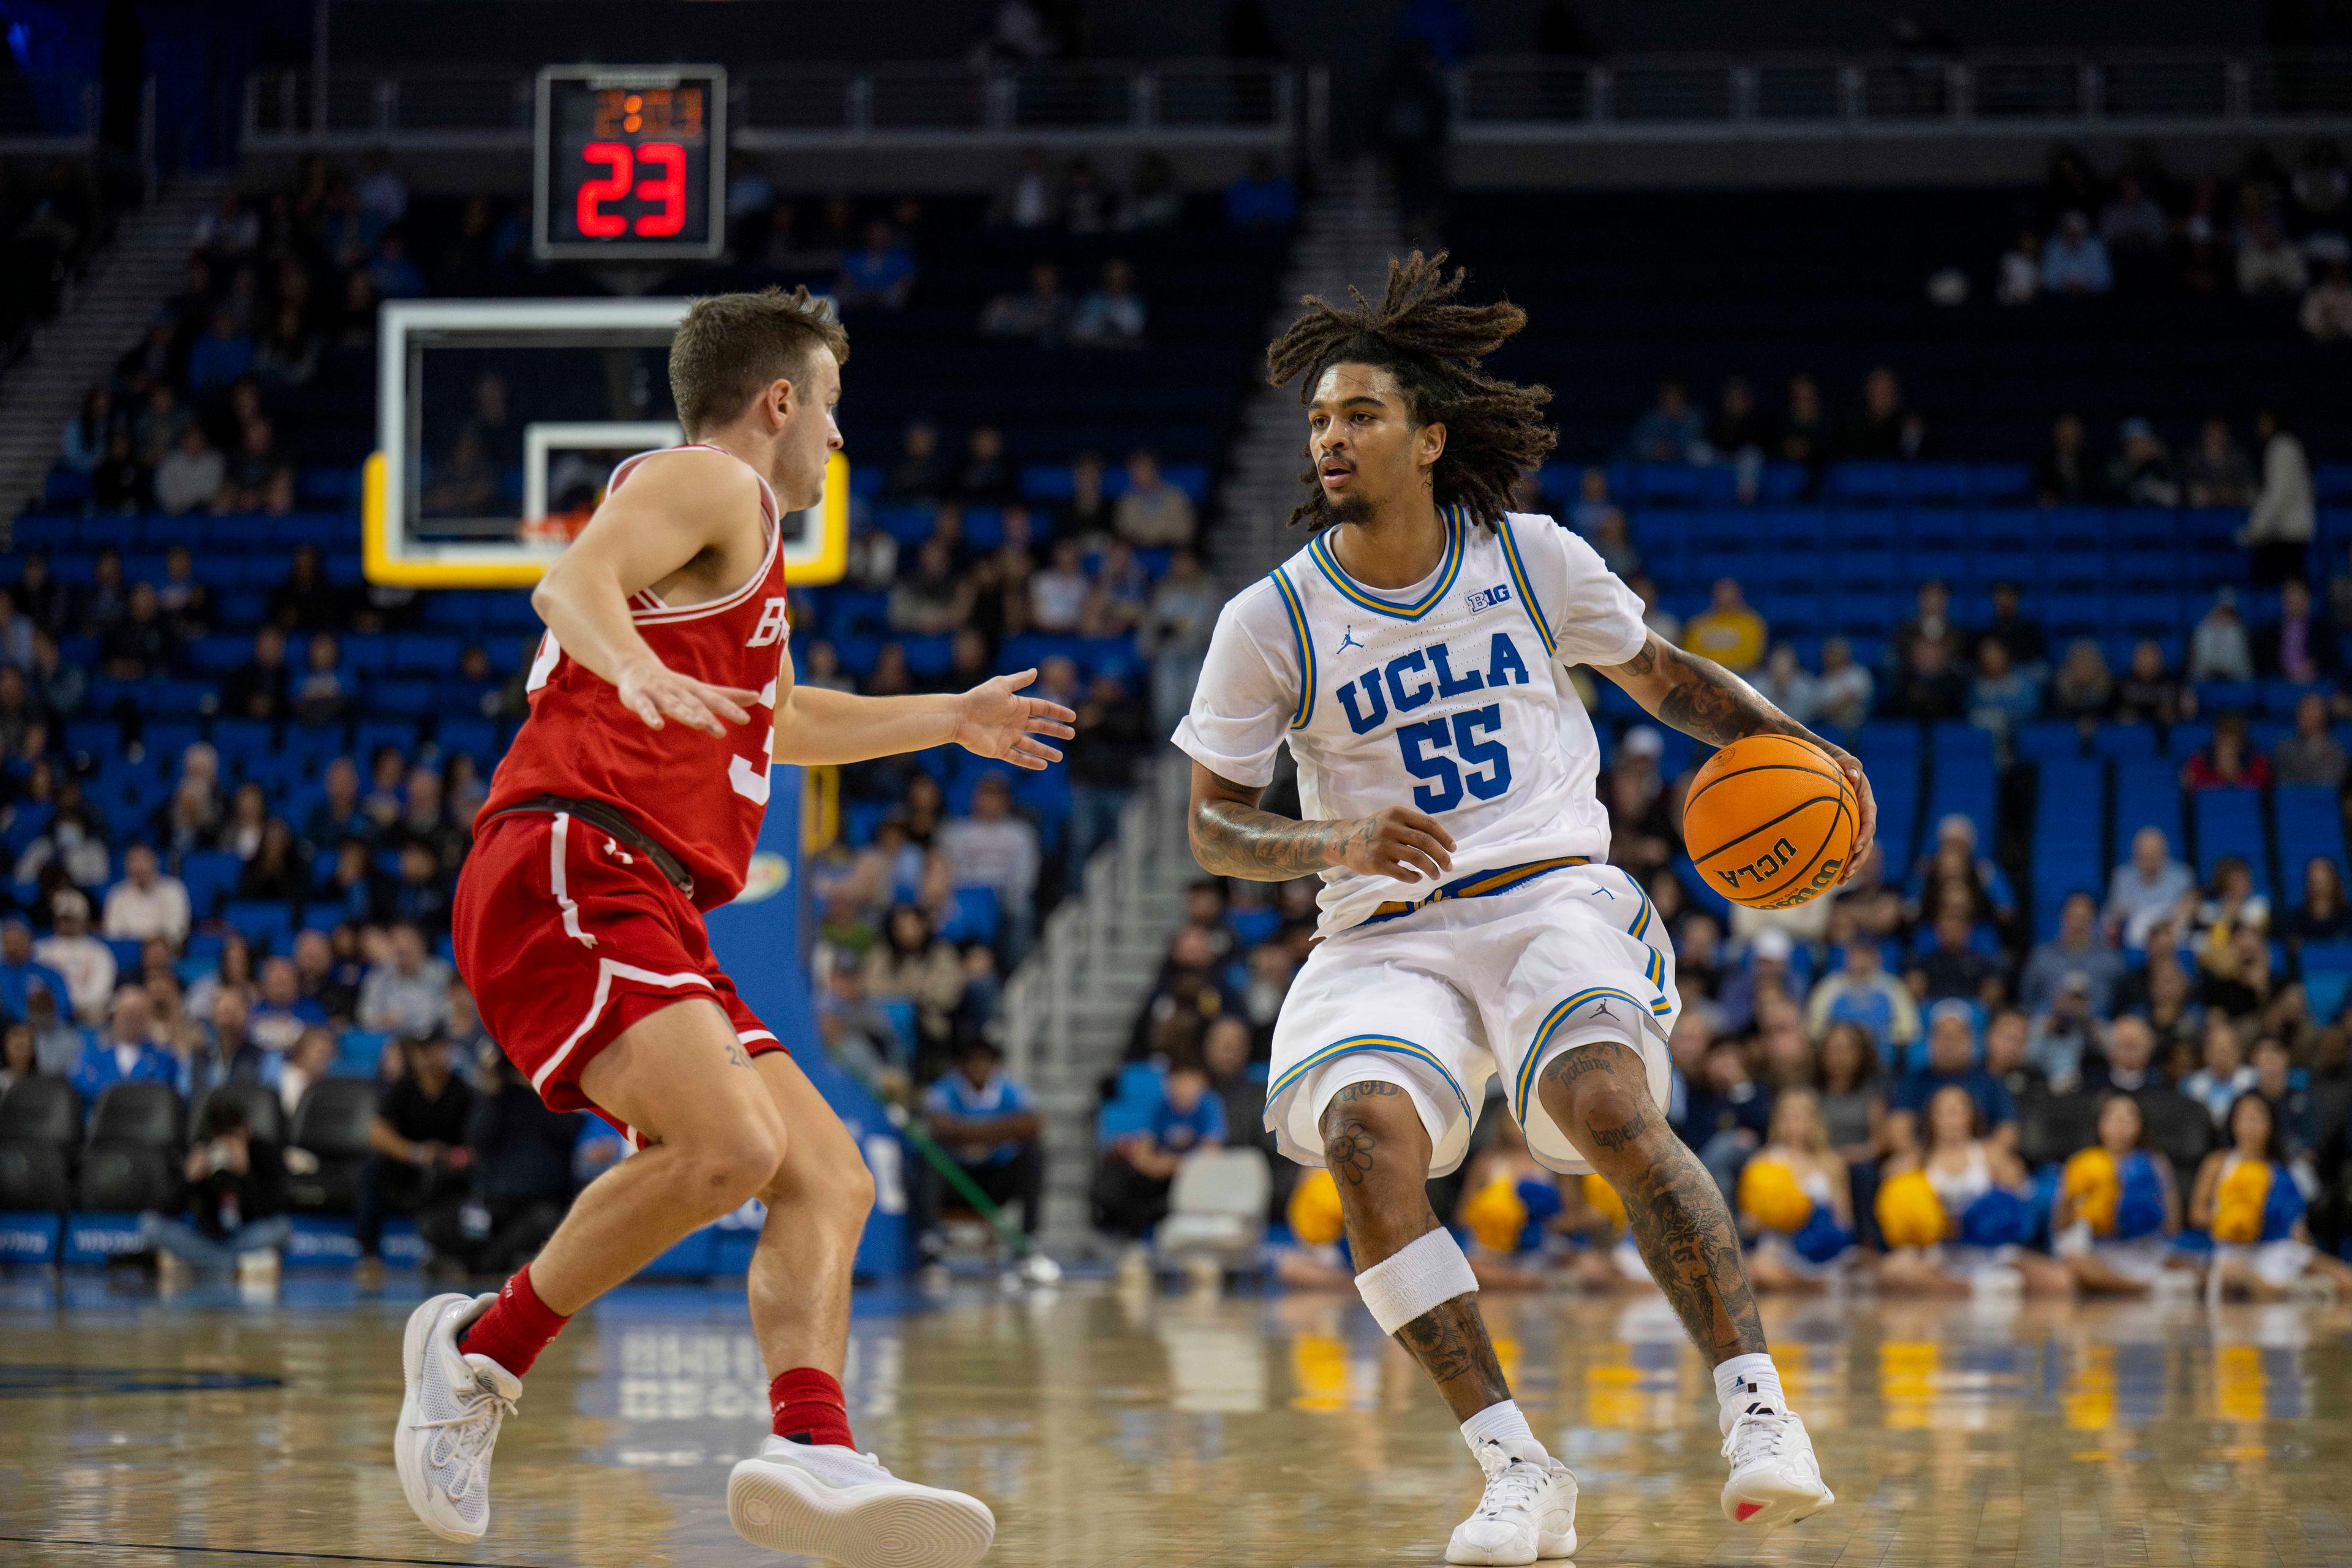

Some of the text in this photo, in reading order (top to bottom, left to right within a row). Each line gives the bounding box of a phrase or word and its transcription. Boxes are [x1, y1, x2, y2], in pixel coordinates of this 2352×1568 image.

[576, 141, 686, 237] 23
[1336, 633, 1529, 735] UCLA
[1396, 703, 1512, 815] 55
[1713, 837, 1798, 888] UCLA
[1559, 1056, 1615, 1088] nothing
[1585, 1099, 1647, 1153] happened
